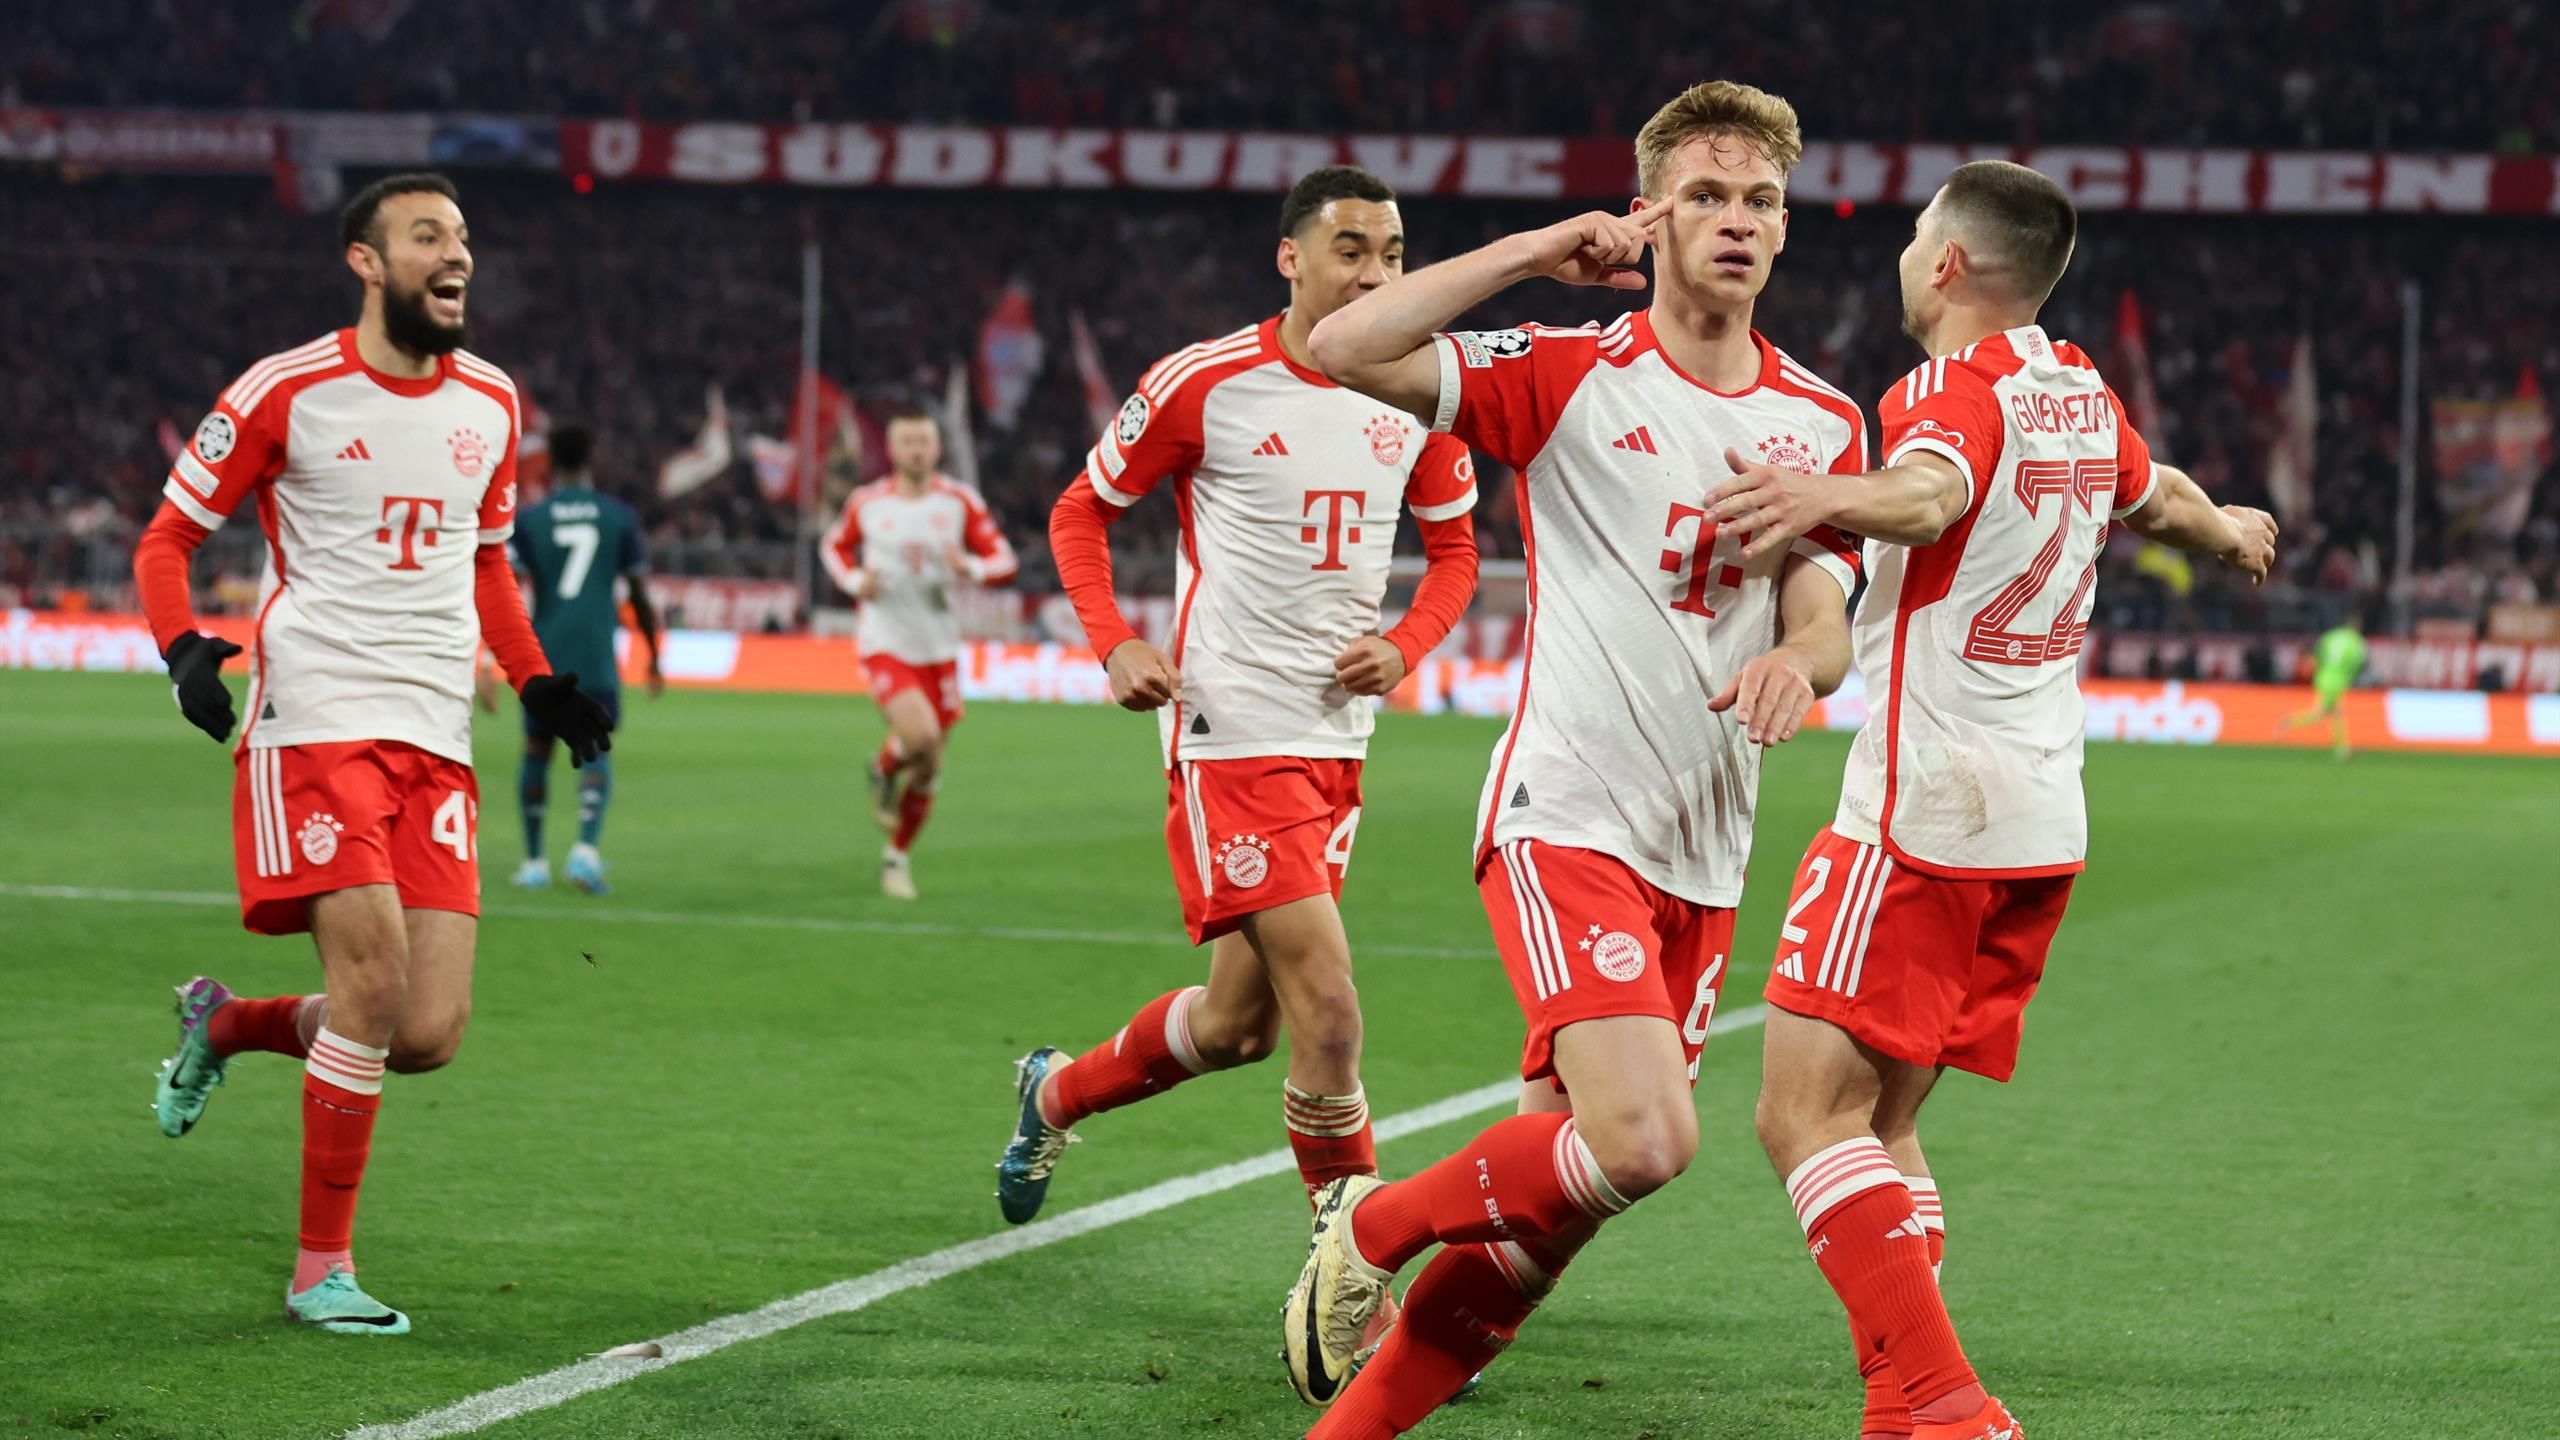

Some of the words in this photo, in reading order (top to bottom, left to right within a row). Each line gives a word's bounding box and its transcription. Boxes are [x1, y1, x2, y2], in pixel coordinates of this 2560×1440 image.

[1800, 141, 2488, 214] ÜNCHEN
[377, 496, 445, 571] T
[552, 522, 600, 600] 7
[1300, 490, 1366, 571] T
[431, 790, 478, 862] 4
[1780, 855, 1832, 945] 2
[1683, 954, 1724, 1045] 6
[1476, 1158, 1491, 1190] FC
